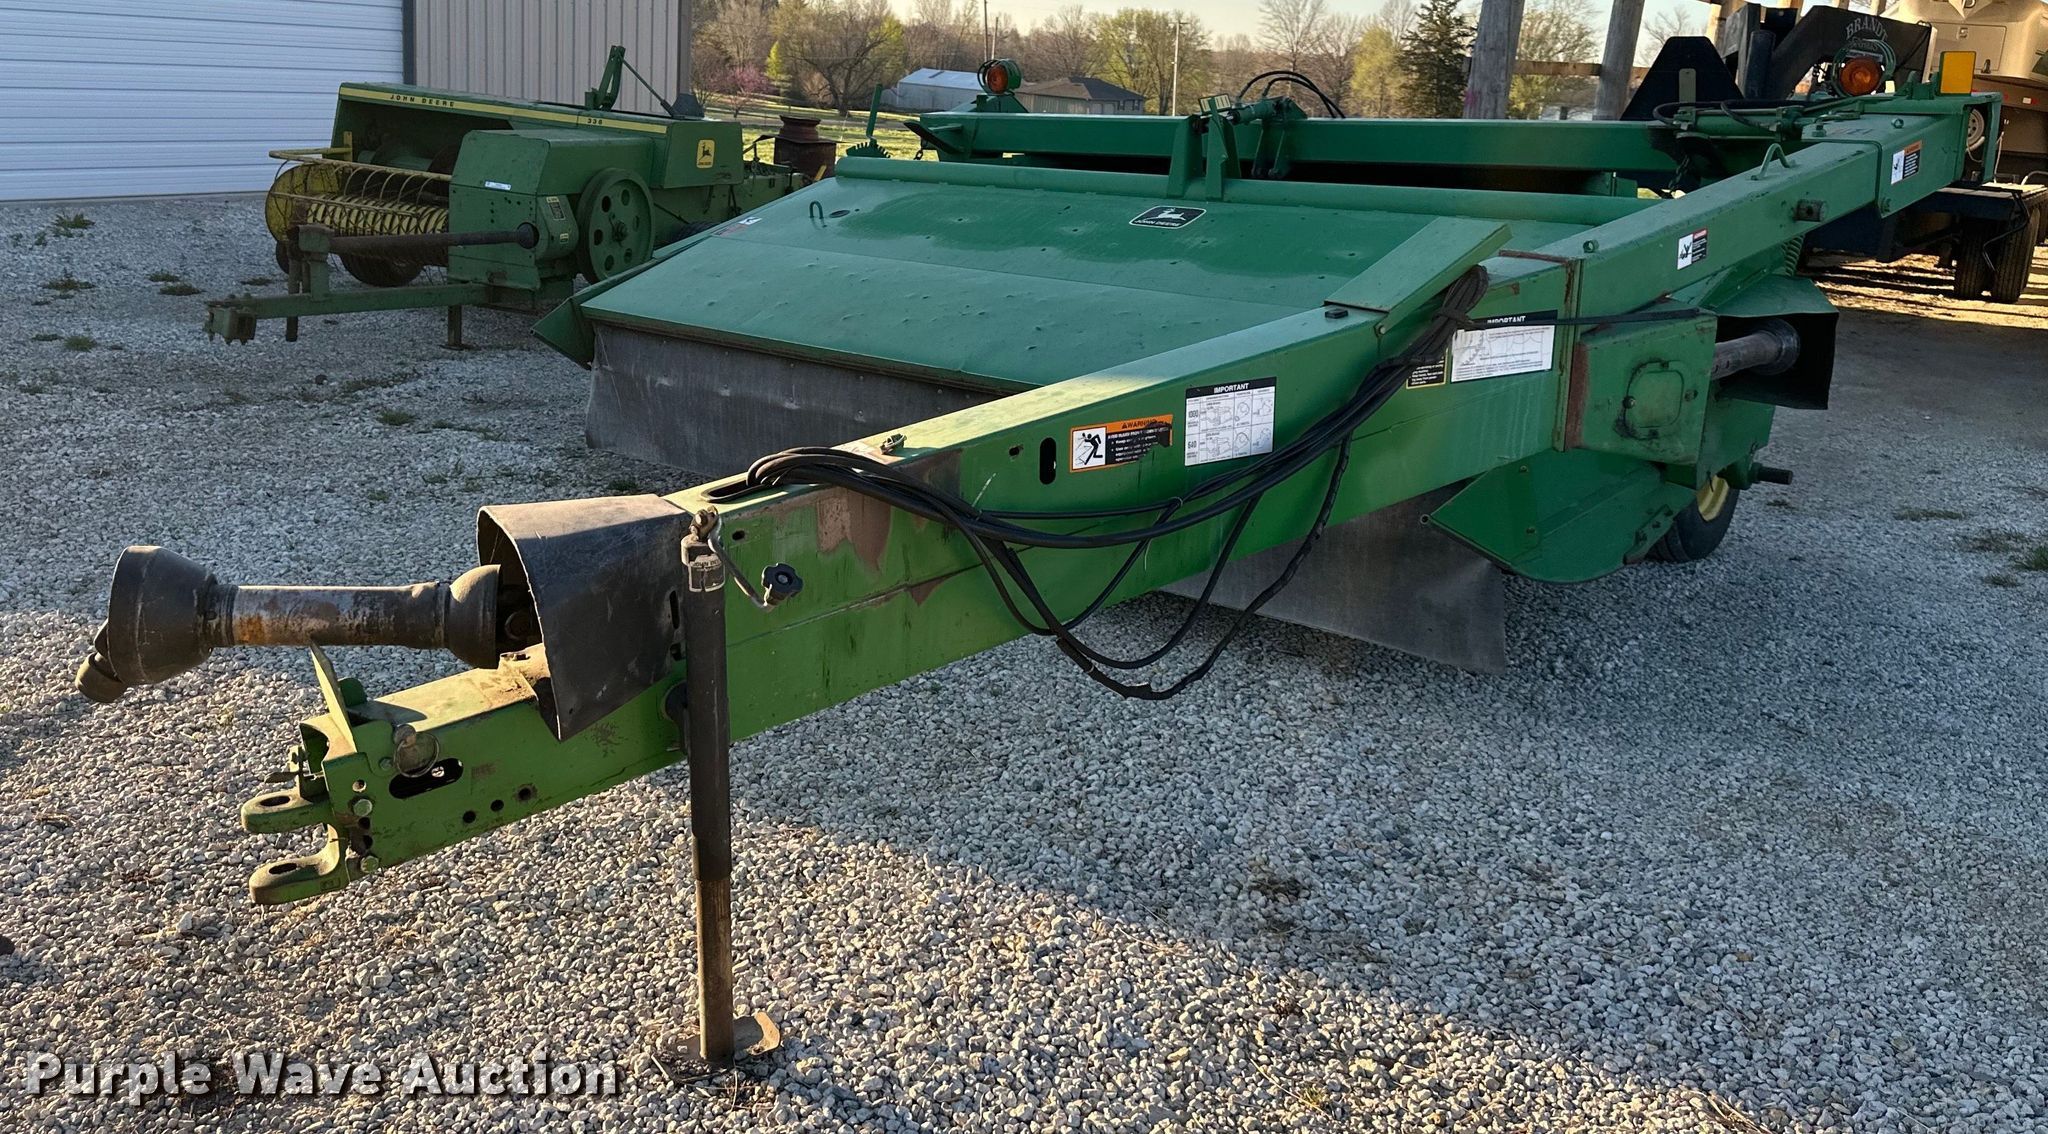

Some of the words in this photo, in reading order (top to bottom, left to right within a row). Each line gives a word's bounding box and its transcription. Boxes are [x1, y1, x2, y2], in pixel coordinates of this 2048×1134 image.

[1845, 15, 1889, 41] BRANDT
[390, 94, 415, 103] JOHN
[421, 97, 455, 107] DEERE
[1487, 315, 1526, 323] IMPORTANT
[1213, 383, 1250, 393] IMPORTANT
[1127, 418, 1158, 429] WARNI
